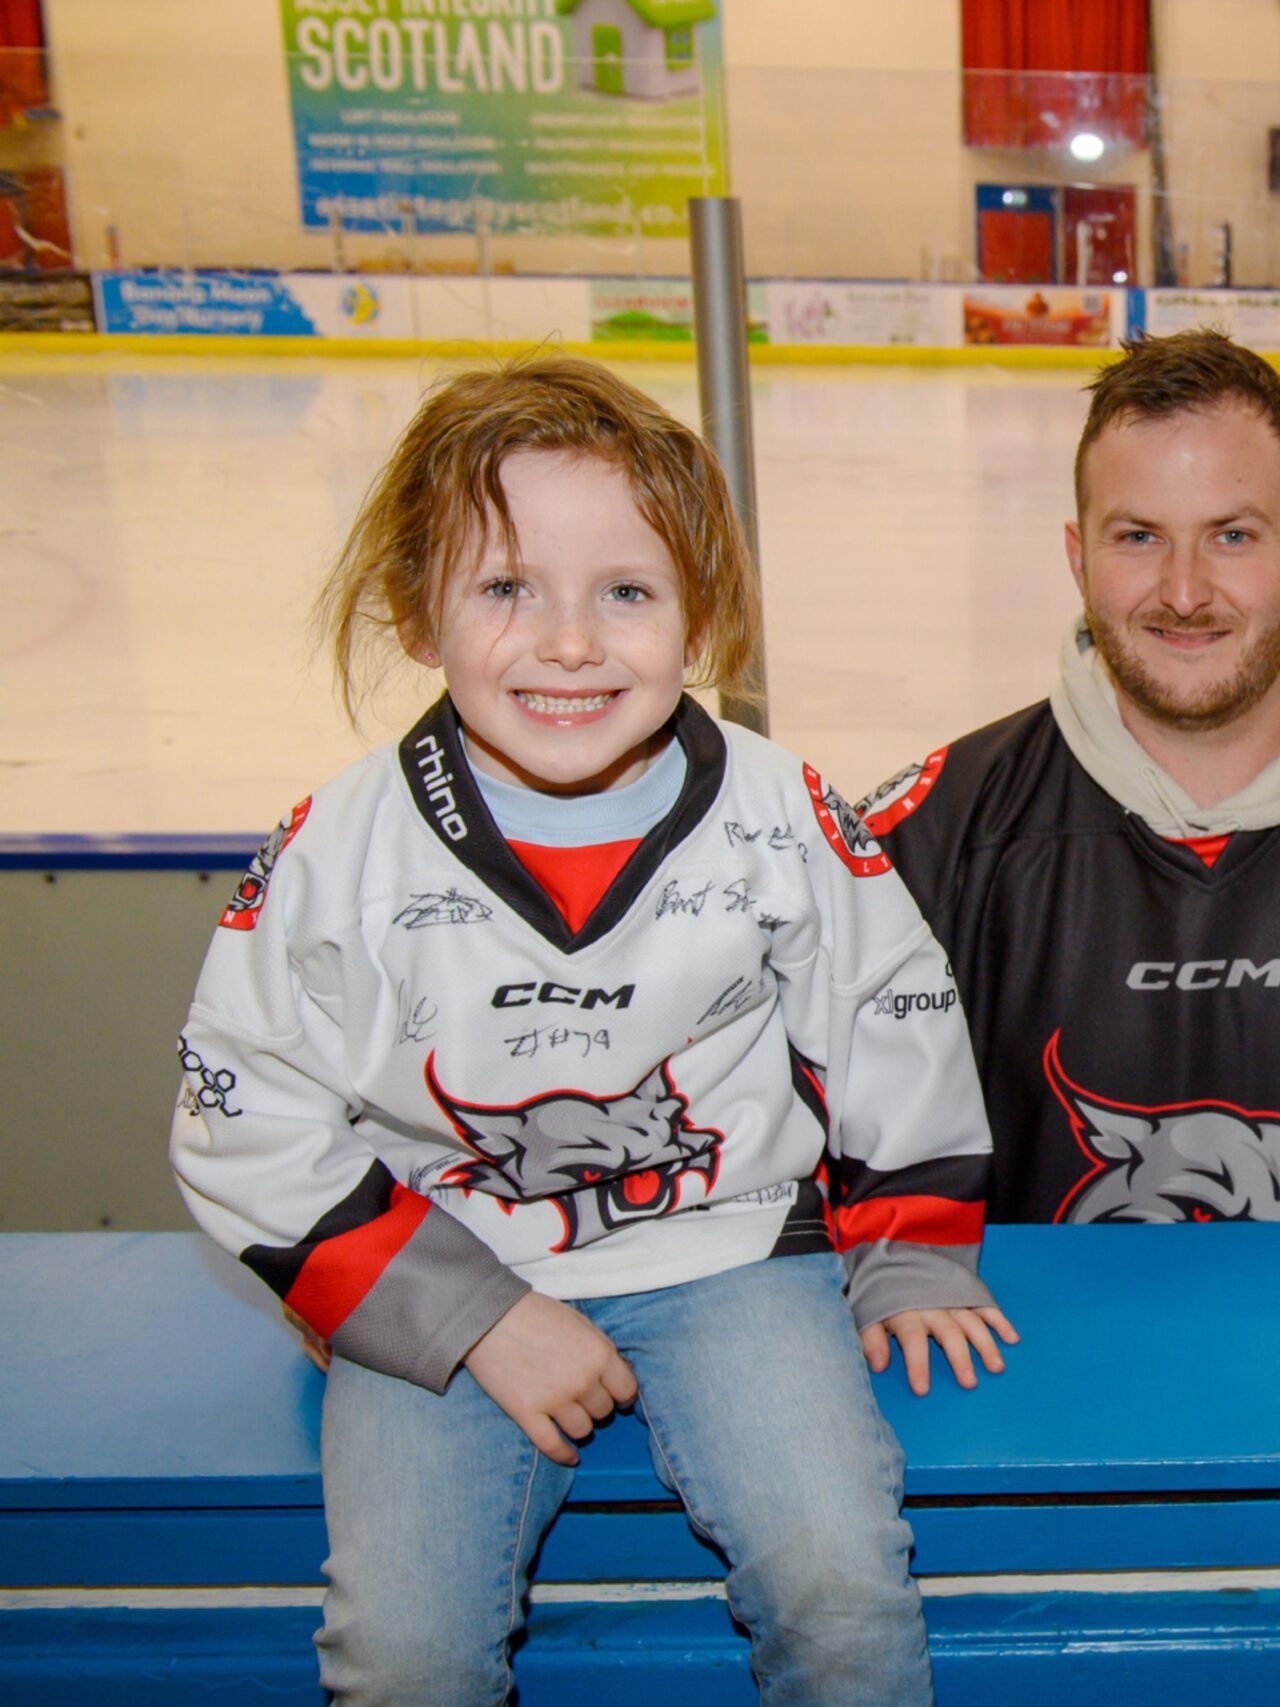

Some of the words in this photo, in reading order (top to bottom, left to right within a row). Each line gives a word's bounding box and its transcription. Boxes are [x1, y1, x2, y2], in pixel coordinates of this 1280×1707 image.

[296, 17, 564, 93] SCOTLAND
[415, 734, 468, 842] rhino
[490, 982, 637, 1010] CCM
